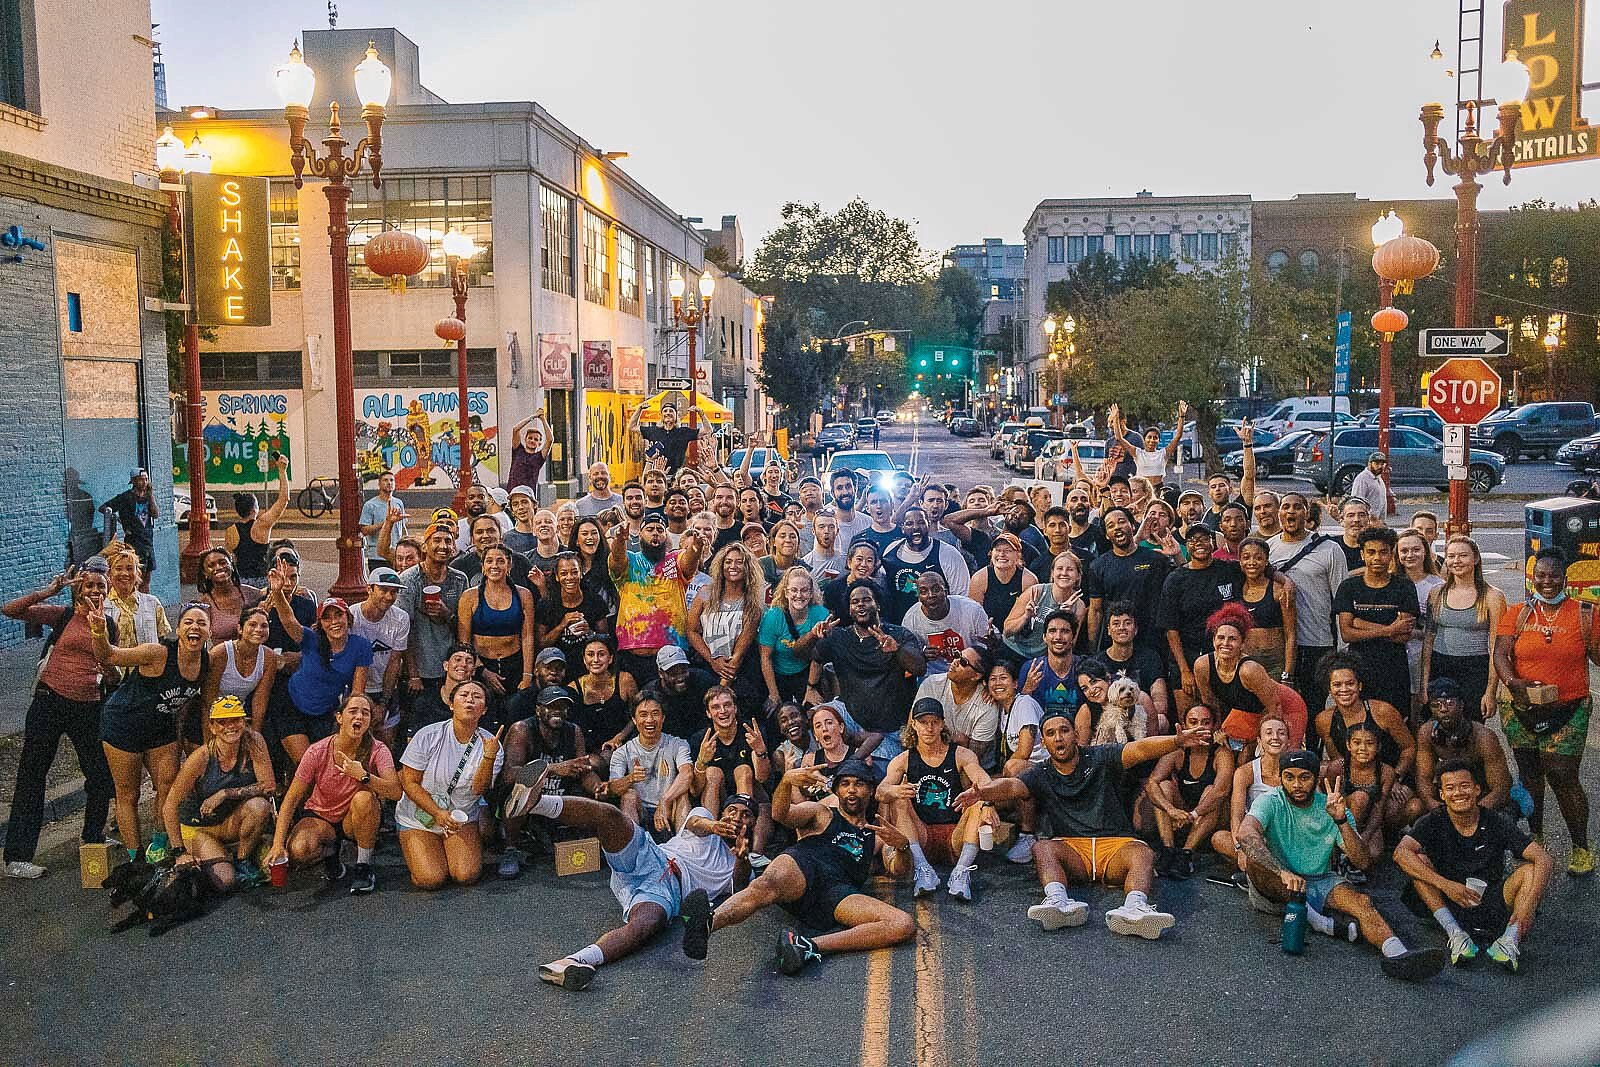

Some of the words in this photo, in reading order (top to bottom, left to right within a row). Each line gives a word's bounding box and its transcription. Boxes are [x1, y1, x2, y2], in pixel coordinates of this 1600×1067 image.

[1520, 12, 1566, 132] LOW
[1487, 132, 1588, 163] CKTAILS
[221, 181, 245, 319] SHAKE
[1434, 337, 1456, 347] ONE
[1460, 337, 1484, 347] WAY
[218, 393, 288, 416] SPRING
[1432, 379, 1496, 405] STOP
[362, 393, 410, 419] ALL
[224, 441, 254, 460] ME
[381, 444, 418, 470] TO
